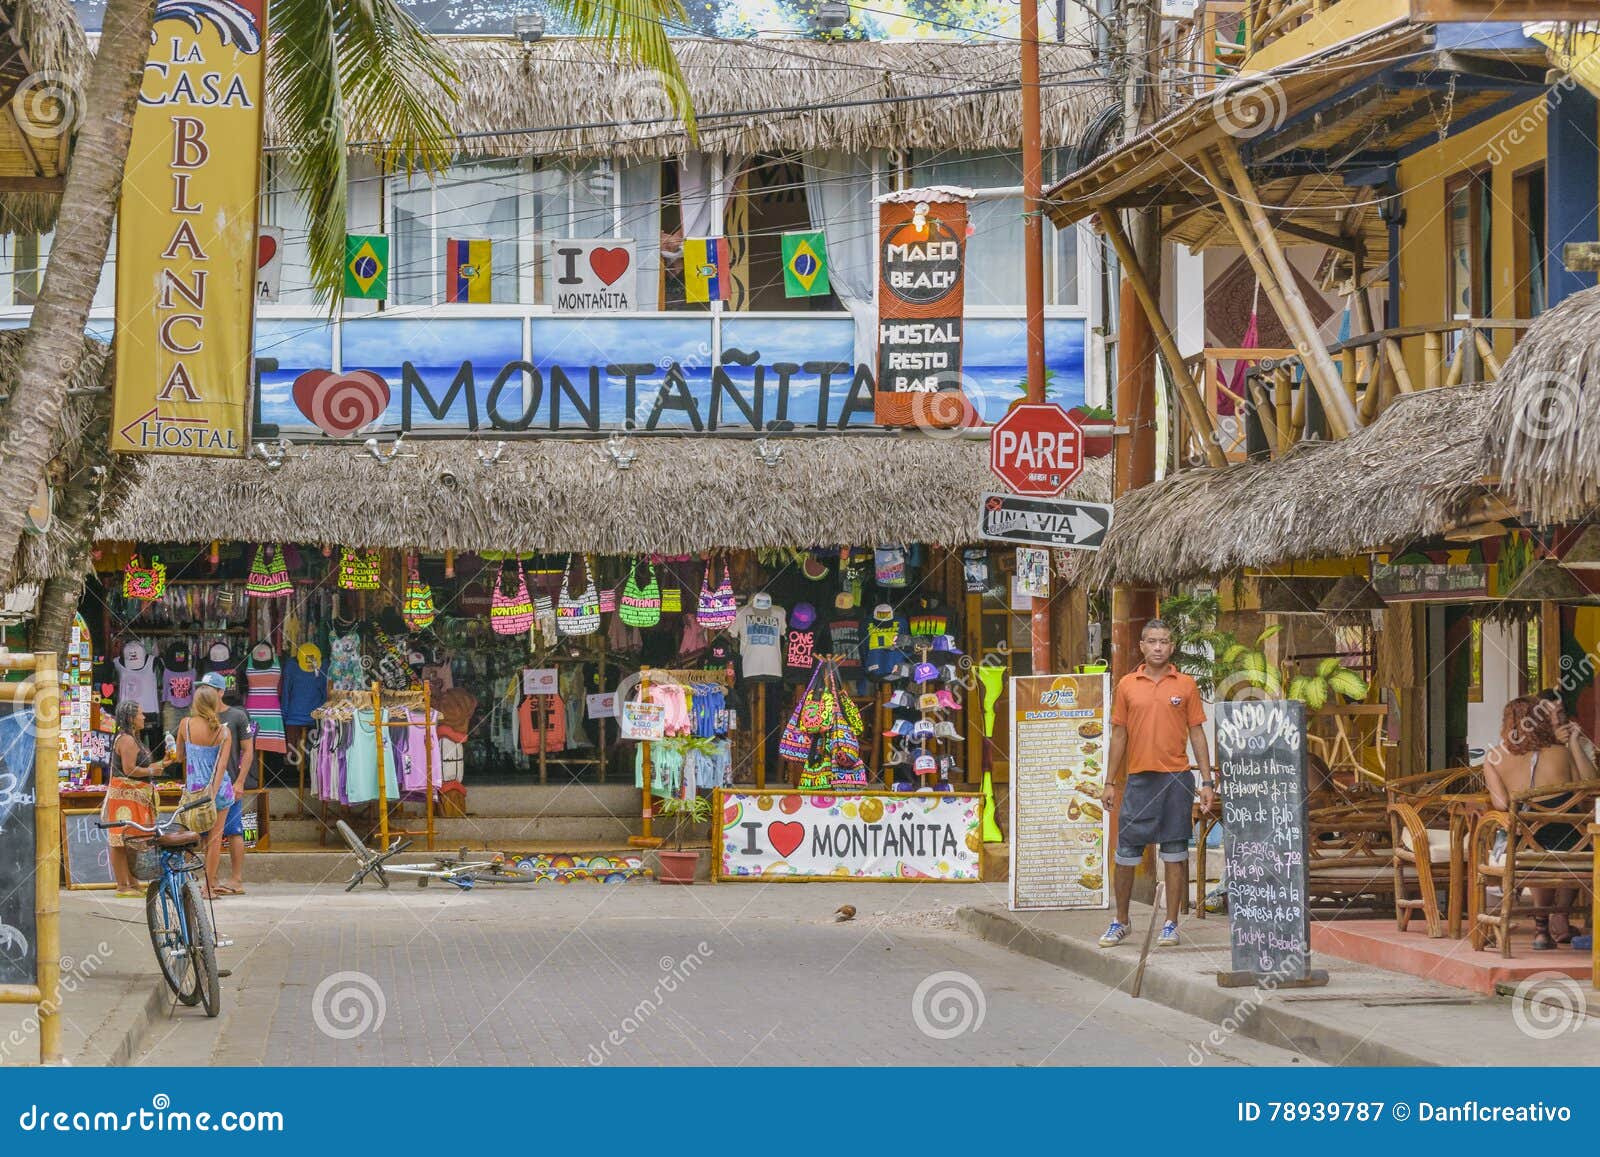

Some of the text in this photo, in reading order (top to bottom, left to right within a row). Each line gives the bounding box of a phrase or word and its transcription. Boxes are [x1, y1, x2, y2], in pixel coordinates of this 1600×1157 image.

[171, 37, 205, 64] LA
[138, 62, 253, 108] CASA
[557, 248, 583, 285] I
[890, 270, 956, 289] BEACH
[558, 287, 628, 309] MONTAÑITA
[880, 322, 960, 344] HOSTAL
[888, 351, 948, 370] RESTO
[402, 348, 876, 433] MONTAÑITA
[895, 376, 939, 393] BAR
[140, 421, 240, 449] HOSTAL
[999, 430, 1075, 469] PARE
[1036, 514, 1074, 534] VIA
[788, 631, 814, 643] ONE
[788, 644, 814, 656] HOT
[1026, 709, 1094, 719] PLATOS FUERTES
[1255, 800, 1267, 824] de
[740, 812, 958, 858] I MONTAÑITA
